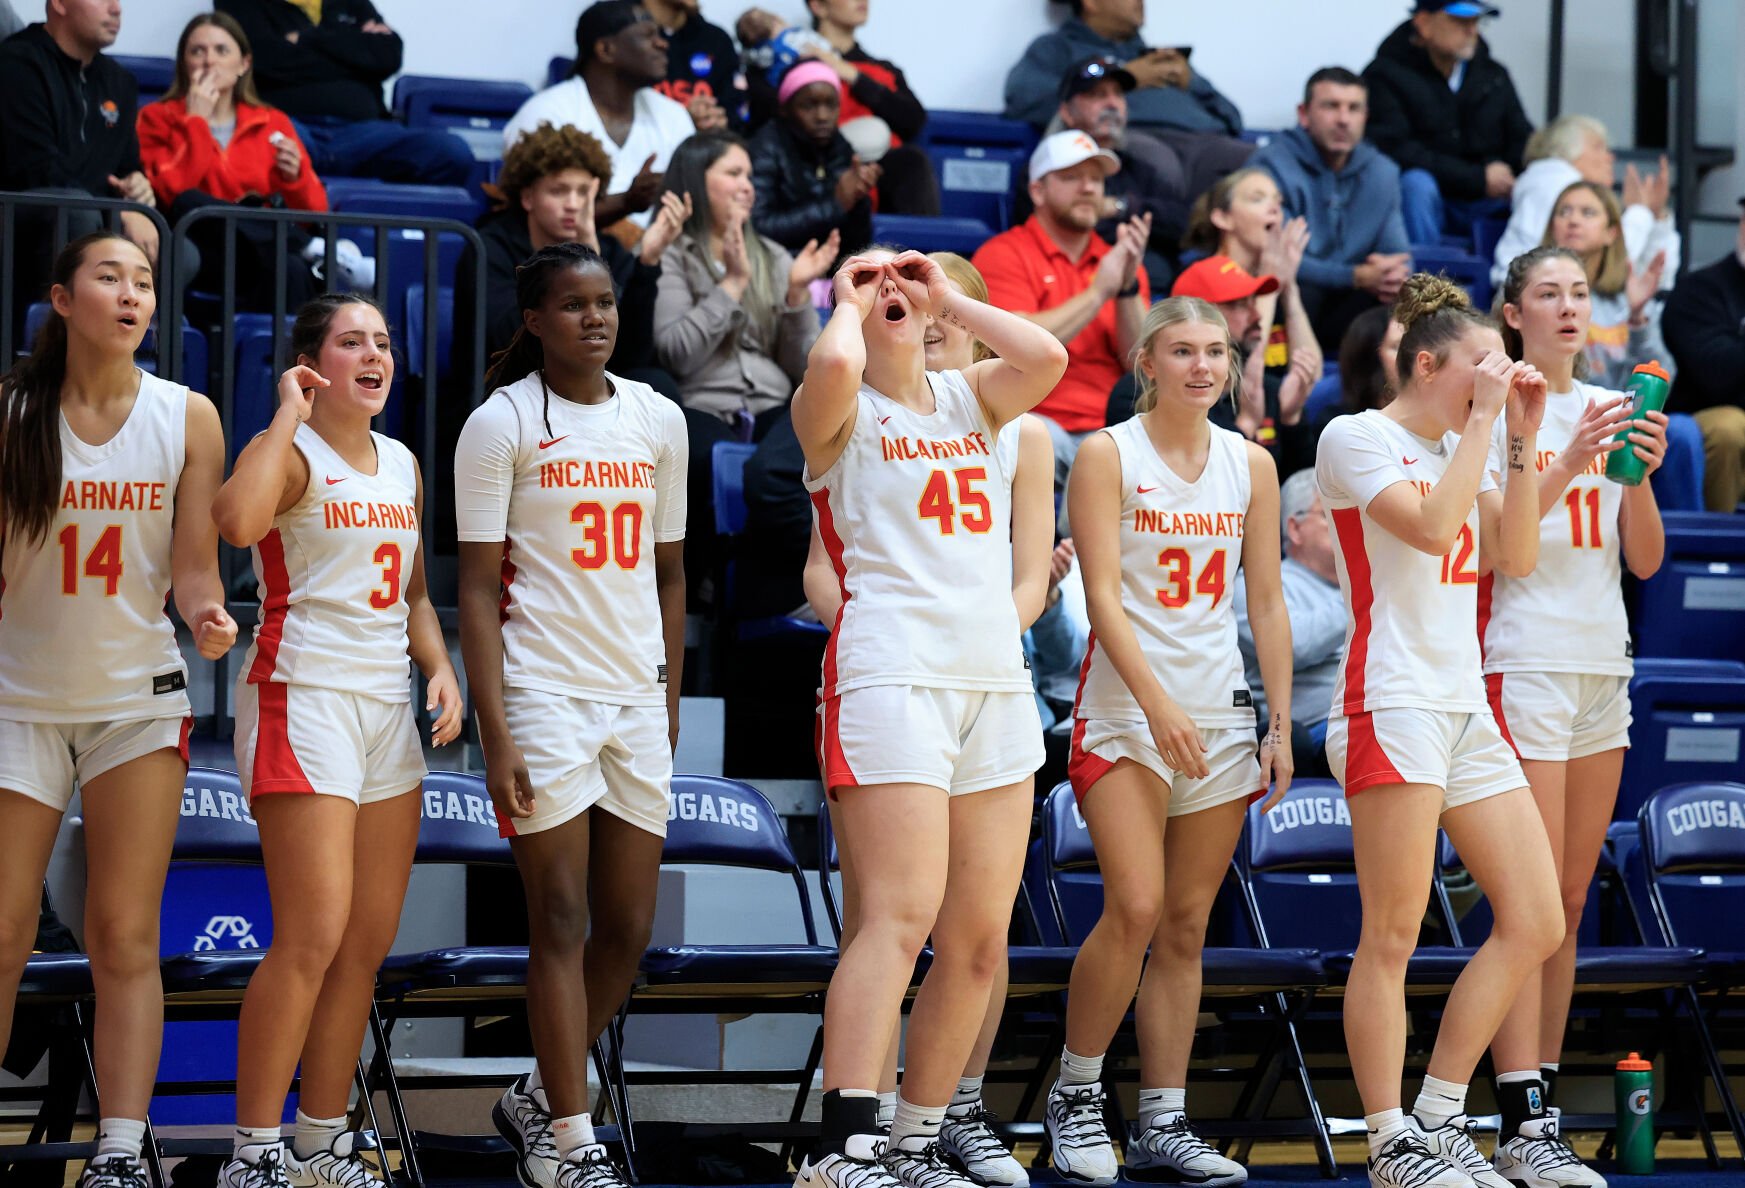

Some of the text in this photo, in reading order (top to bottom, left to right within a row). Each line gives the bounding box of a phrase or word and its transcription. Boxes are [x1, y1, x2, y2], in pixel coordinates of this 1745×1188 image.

[61, 480, 166, 511] ARNATE
[324, 502, 416, 531] INCARNA
[917, 466, 993, 536] 45
[1565, 486, 1604, 550] 11
[58, 523, 124, 596] 14
[569, 501, 644, 571] 30
[368, 541, 402, 610] 3
[1156, 547, 1226, 610] 34
[421, 790, 499, 829] GARS
[1267, 797, 1352, 834] COUGA
[1667, 800, 1745, 836] COUGA
